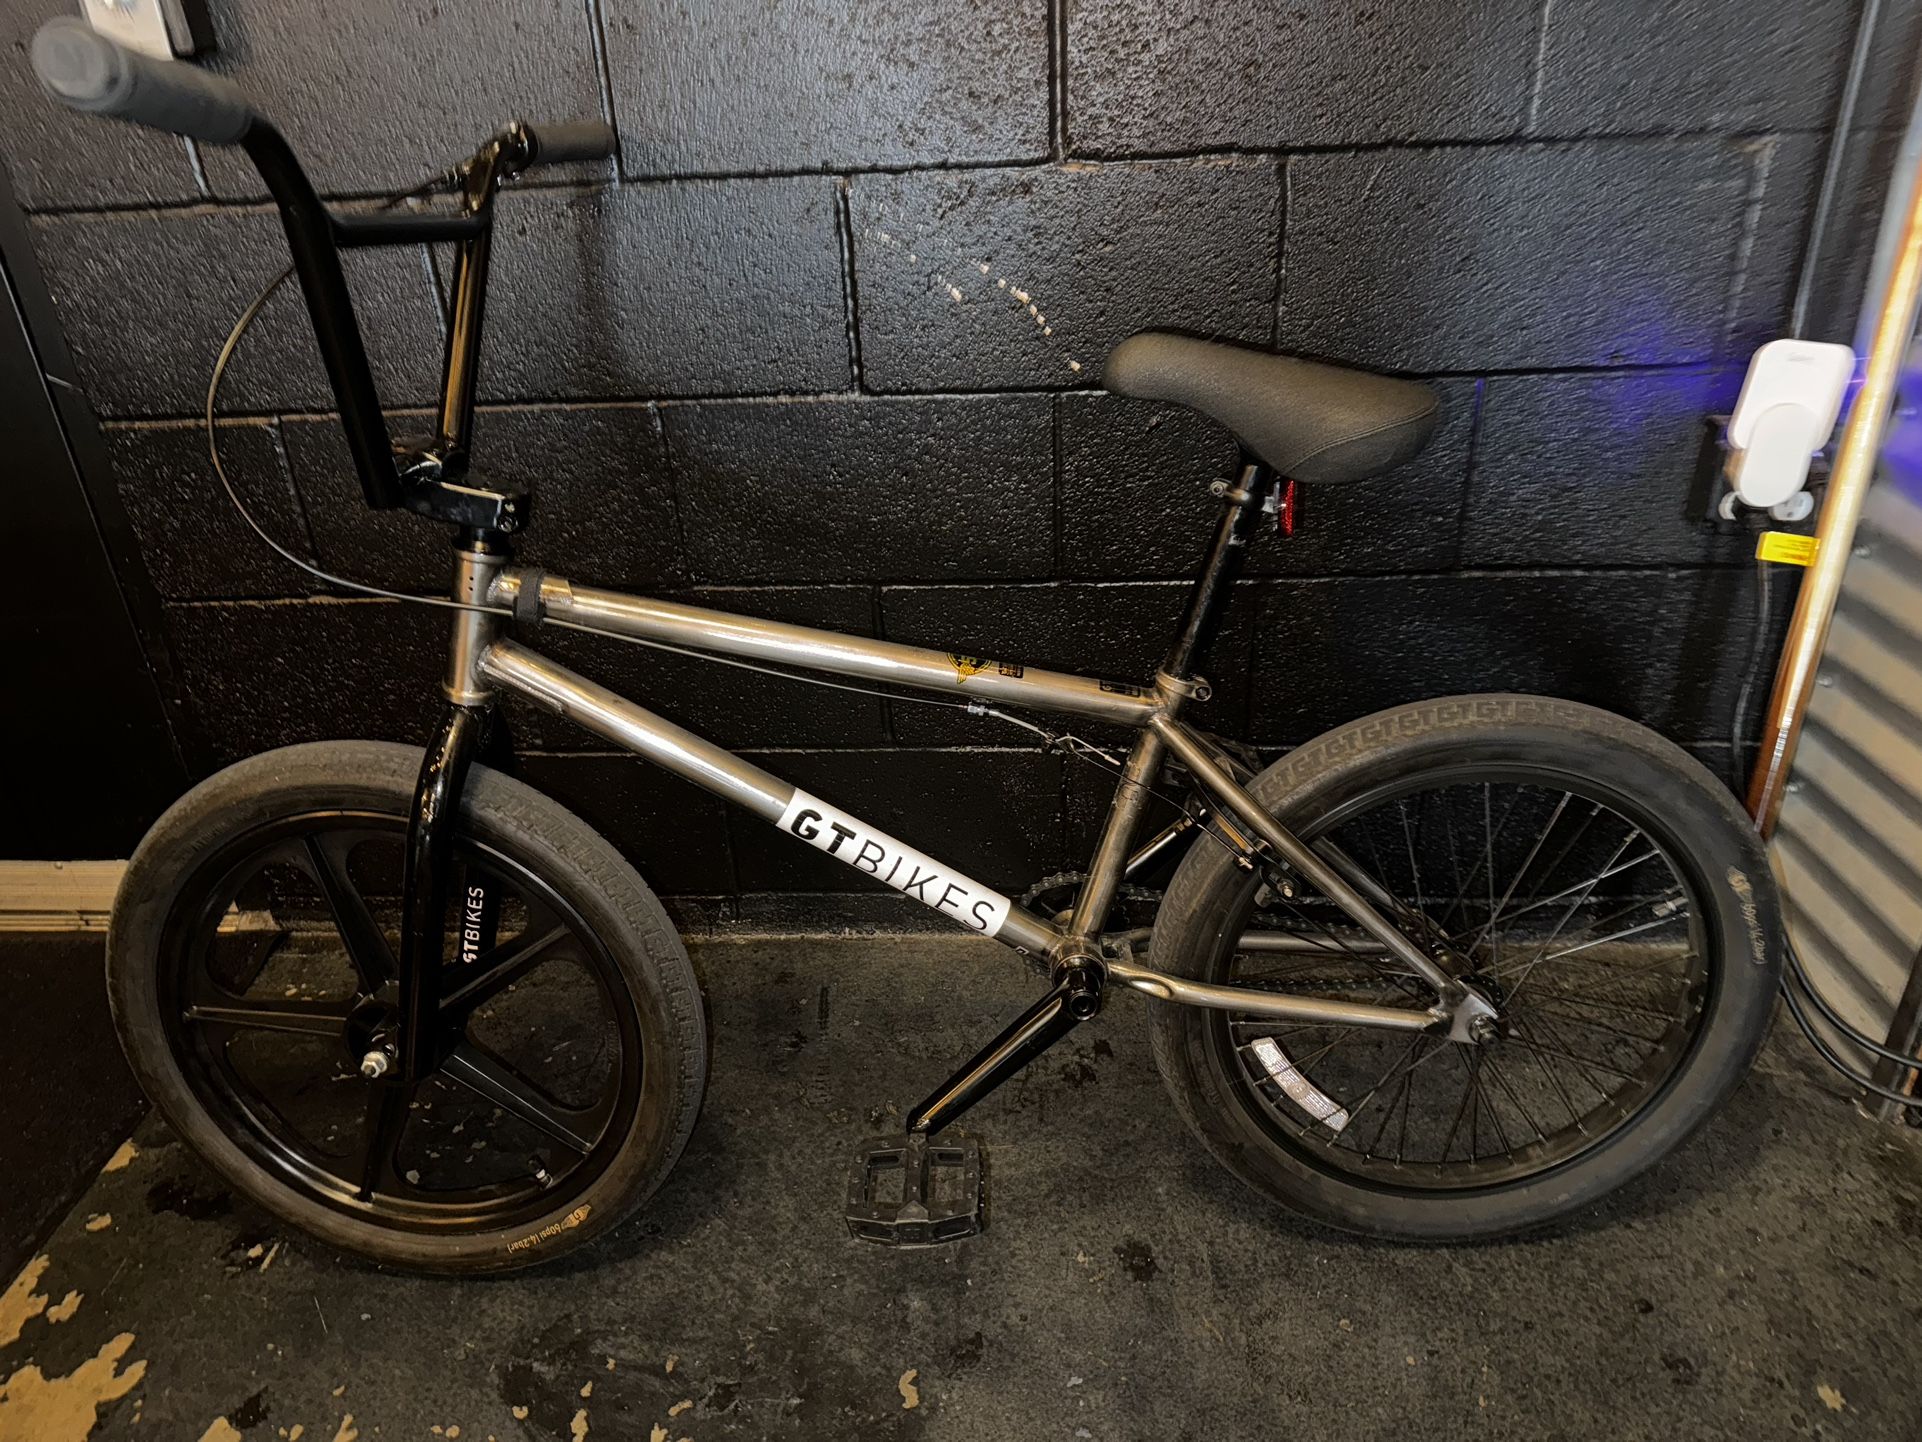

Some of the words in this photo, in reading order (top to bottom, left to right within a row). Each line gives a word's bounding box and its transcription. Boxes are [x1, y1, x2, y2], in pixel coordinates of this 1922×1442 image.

[790, 808, 995, 931] GTBIKES
[463, 886, 484, 963] GTBIKES
[540, 1223, 561, 1241] 60psi
